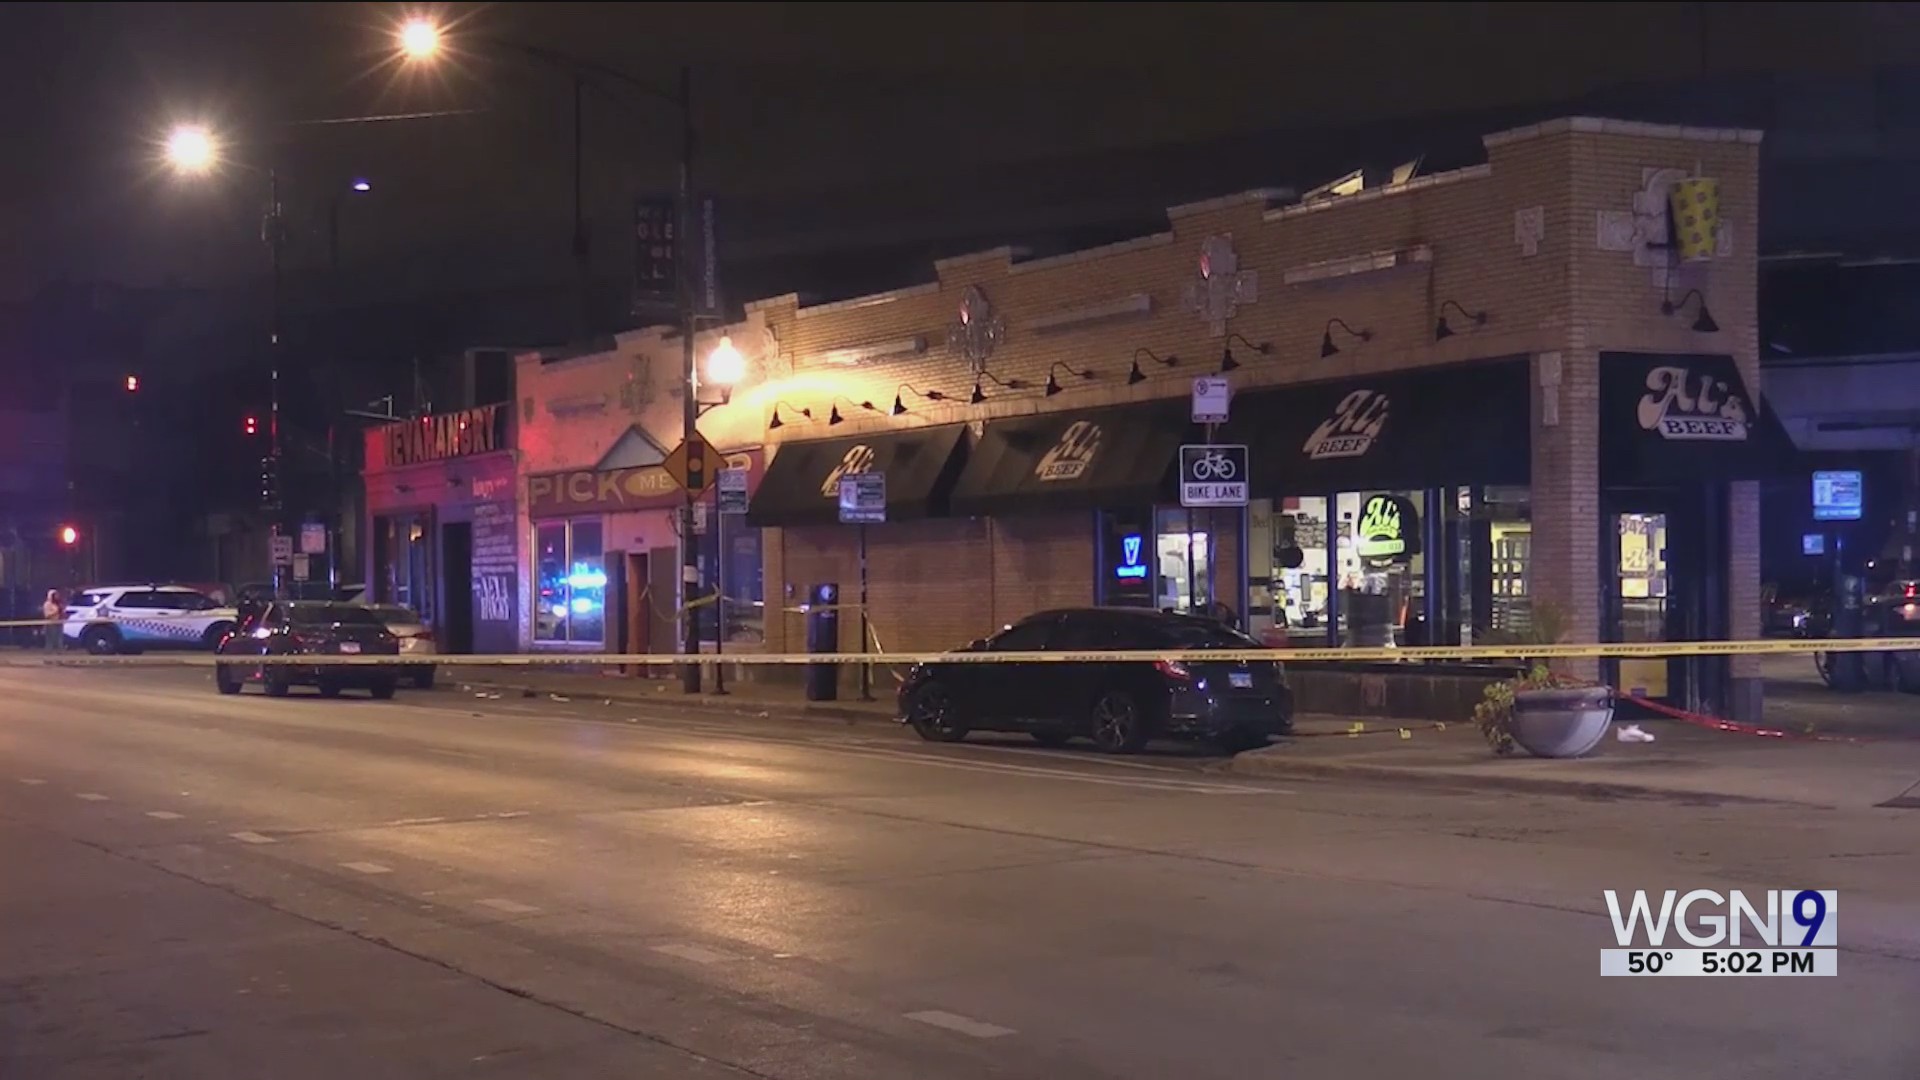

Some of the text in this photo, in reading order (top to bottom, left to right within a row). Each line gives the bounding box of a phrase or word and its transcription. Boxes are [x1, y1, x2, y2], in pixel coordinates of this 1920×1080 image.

[1637, 366, 1747, 430] Al's
[1302, 389, 1389, 453] Al's
[1664, 420, 1737, 434] BEEF
[1316, 438, 1368, 455] BEEF
[1044, 463, 1083, 477] BEEF
[531, 469, 625, 505] PICK
[639, 476, 672, 490] ME
[1187, 486, 1242, 499] BIKE LANE
